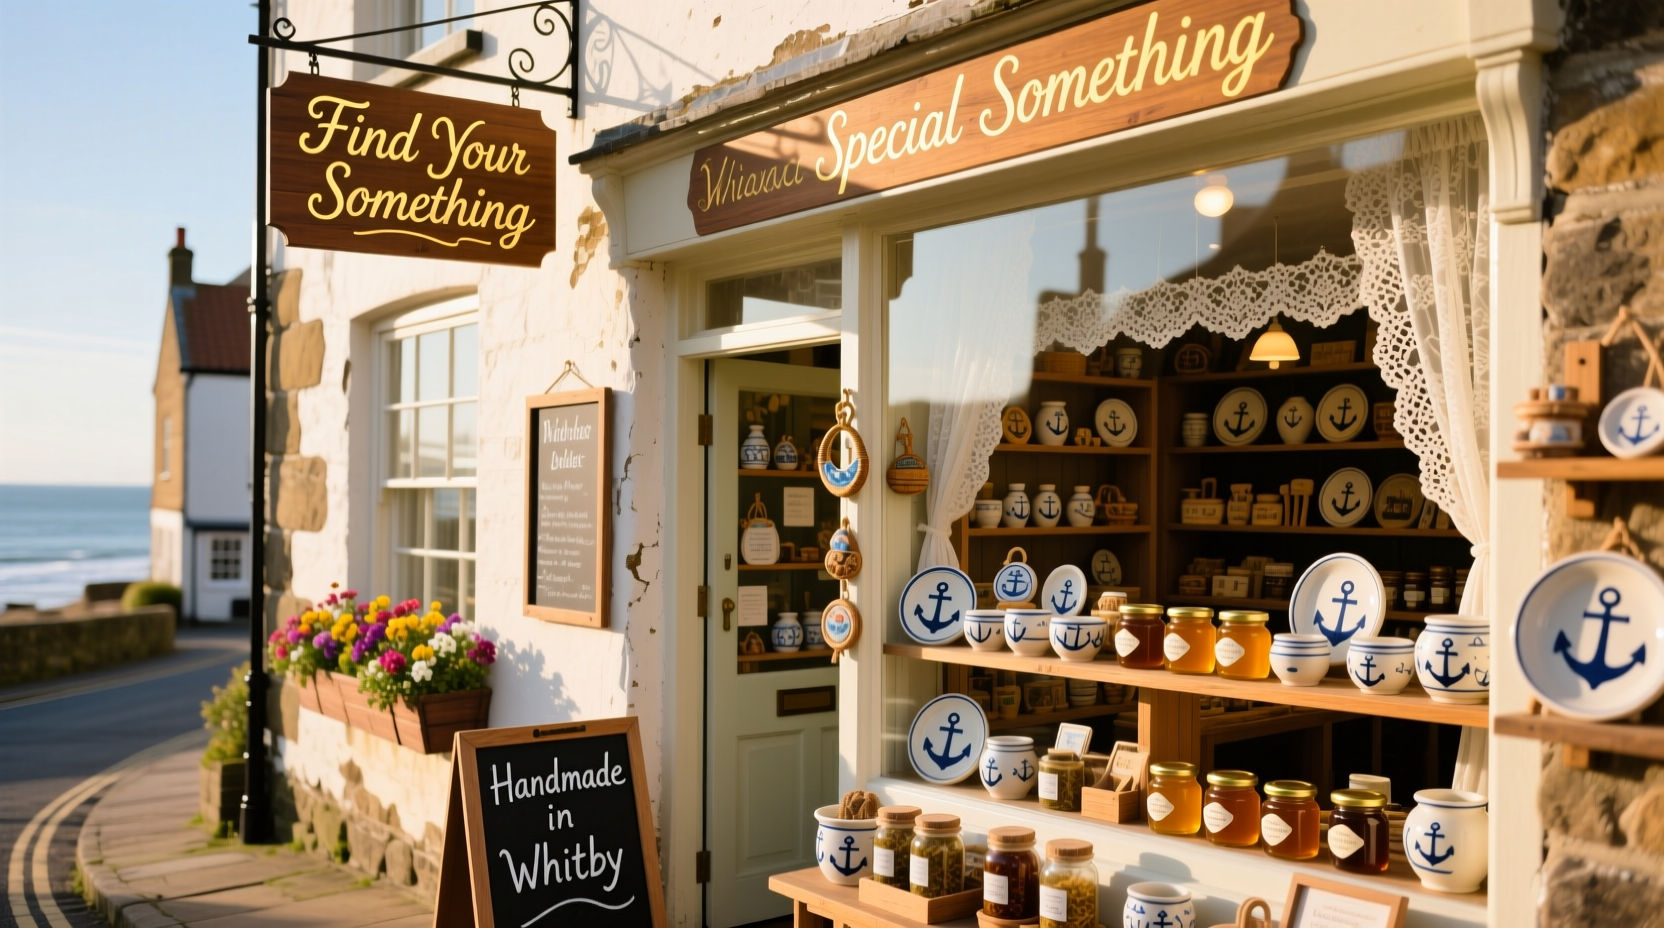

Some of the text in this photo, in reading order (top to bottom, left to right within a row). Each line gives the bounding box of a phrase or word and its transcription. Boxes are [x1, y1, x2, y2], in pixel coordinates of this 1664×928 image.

[299, 95, 530, 179] Find Your
[815, 73, 964, 195] Special
[979, 11, 1274, 136] Something
[307, 161, 536, 249] Something
[490, 751, 626, 805] Handmade
[548, 804, 574, 830] in
[499, 834, 623, 893] Whitby
